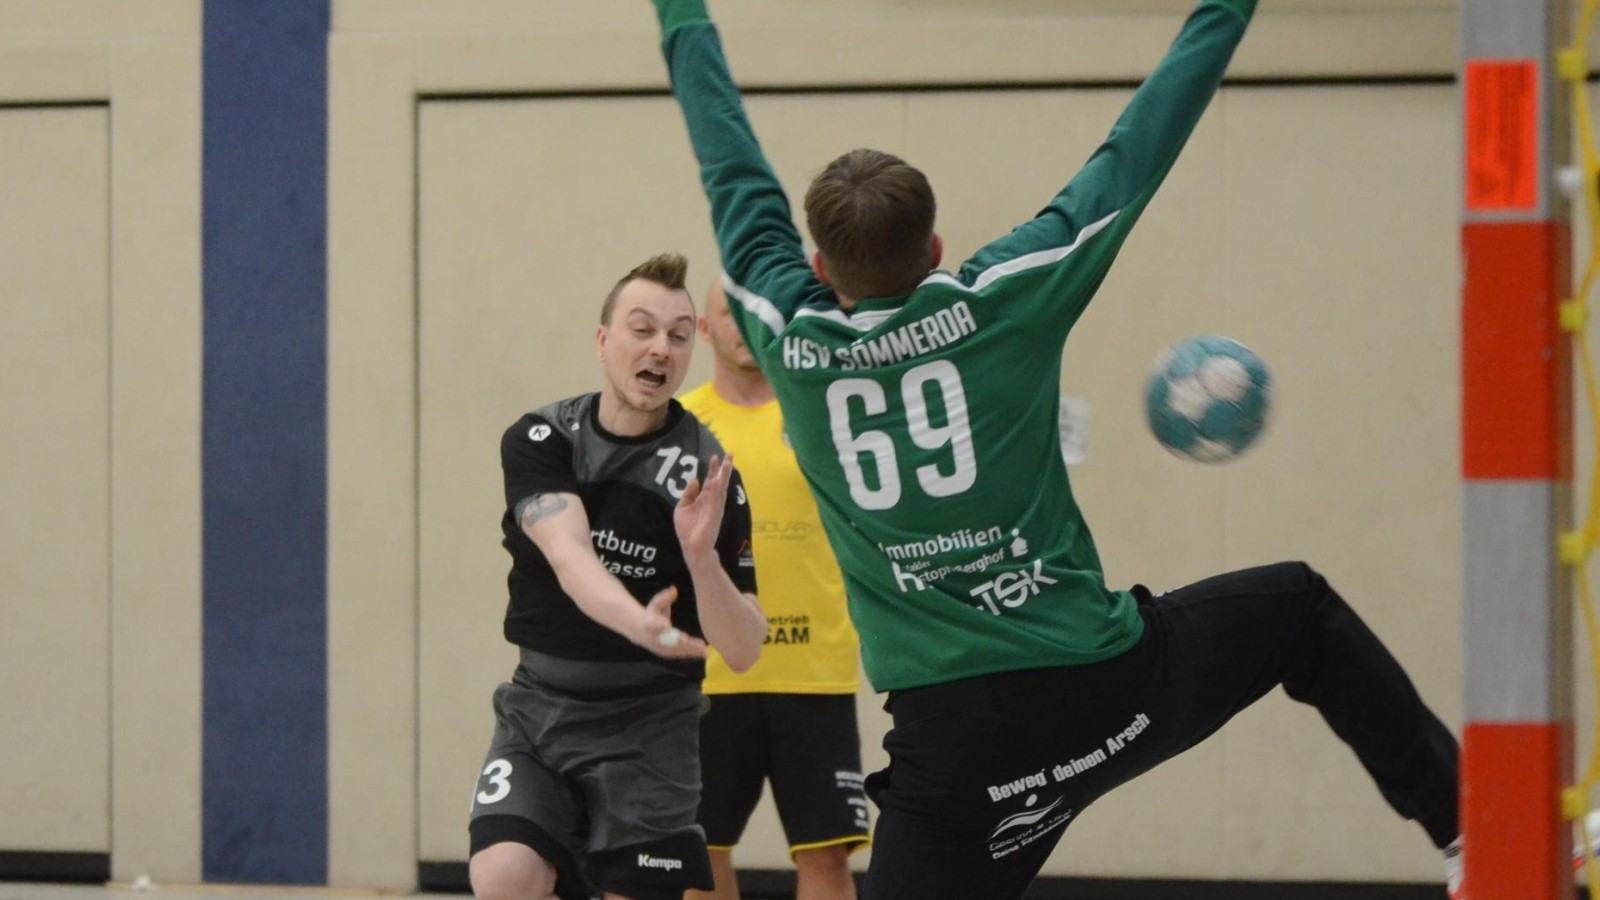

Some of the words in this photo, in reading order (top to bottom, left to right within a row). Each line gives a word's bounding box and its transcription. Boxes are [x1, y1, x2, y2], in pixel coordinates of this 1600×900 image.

[783, 336, 830, 370] HSV
[826, 359, 977, 511] 69
[655, 446, 699, 499] 13
[1052, 748, 1107, 782] deinen
[1105, 713, 1151, 755] Arsch
[471, 758, 513, 810] 3
[638, 854, 682, 871] Kempa
